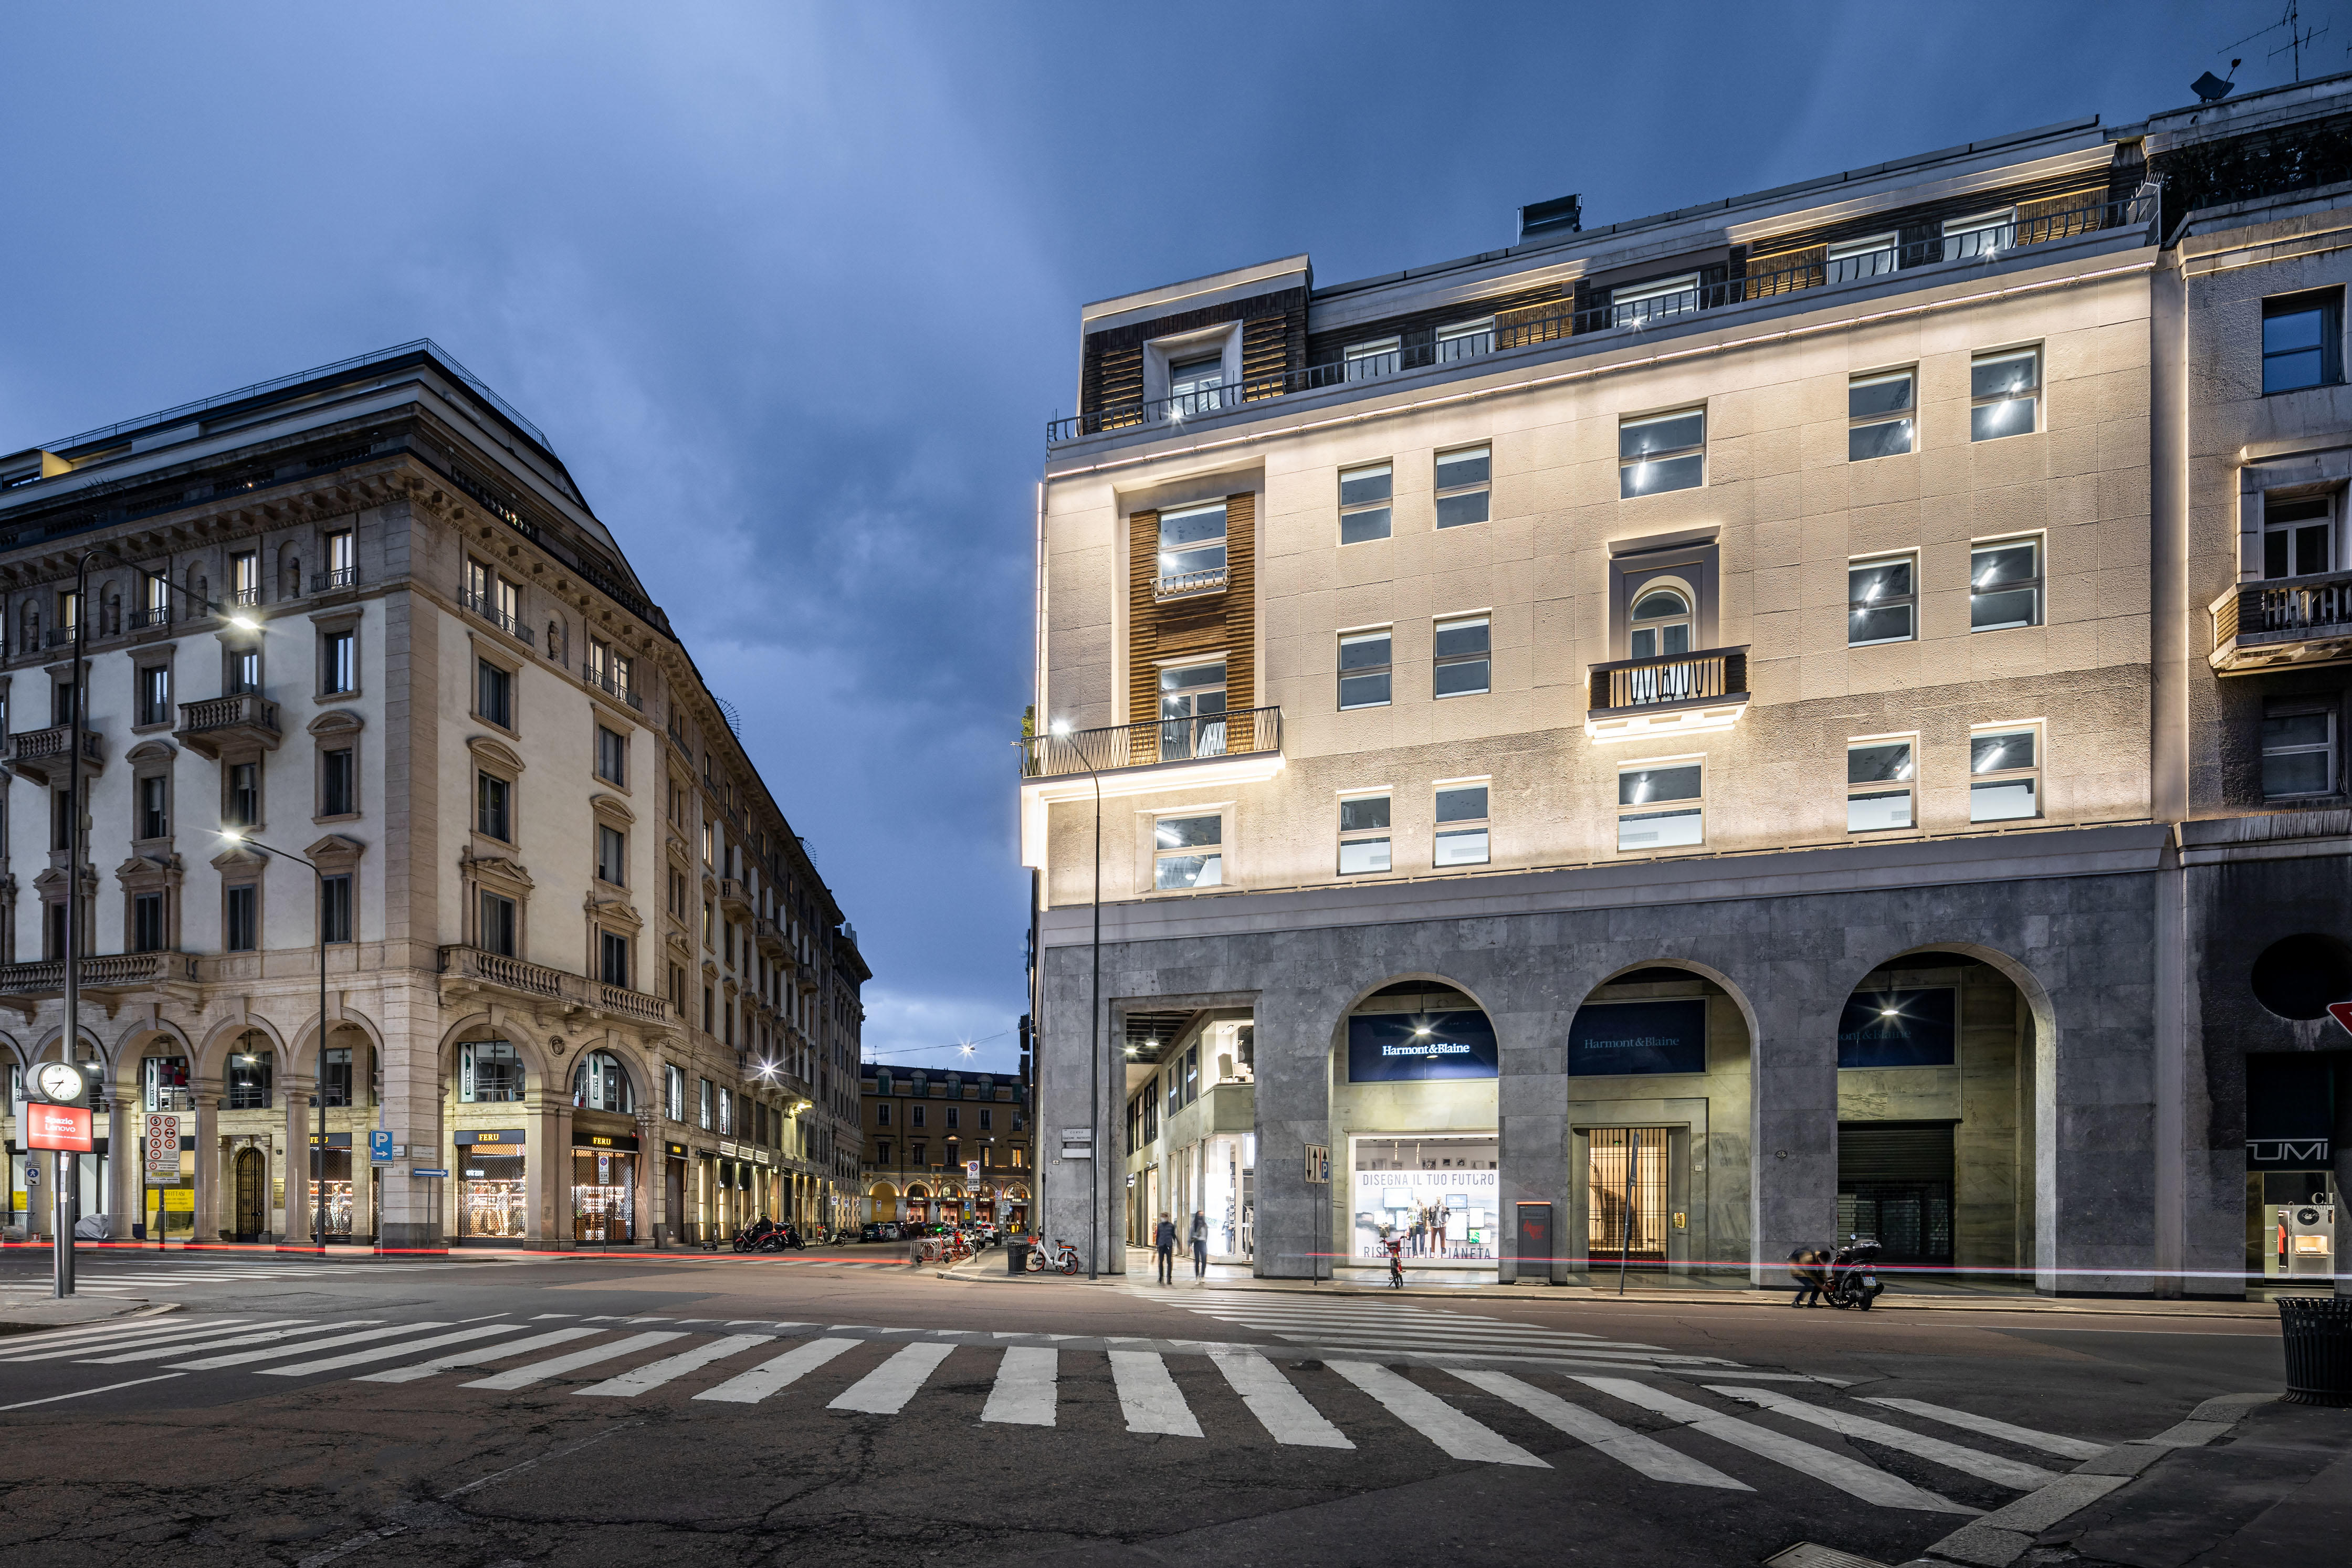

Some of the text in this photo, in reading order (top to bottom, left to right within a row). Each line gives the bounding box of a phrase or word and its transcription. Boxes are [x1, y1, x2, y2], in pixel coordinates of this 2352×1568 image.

[1838, 1029, 1912, 1040] ont&Blaine
[1584, 1037, 1679, 1049] Harmont&Blaine
[1382, 1043, 1470, 1056] Harmont&Blaine
[45, 1116, 74, 1125] Spazio
[45, 1123, 76, 1132] Lenovo
[376, 1132, 388, 1147] P
[1322, 1163, 1328, 1177] P
[1363, 1174, 1494, 1185] DISEGNA IL TUO FUTURO
[1441, 1247, 1490, 1259] PIANETA
